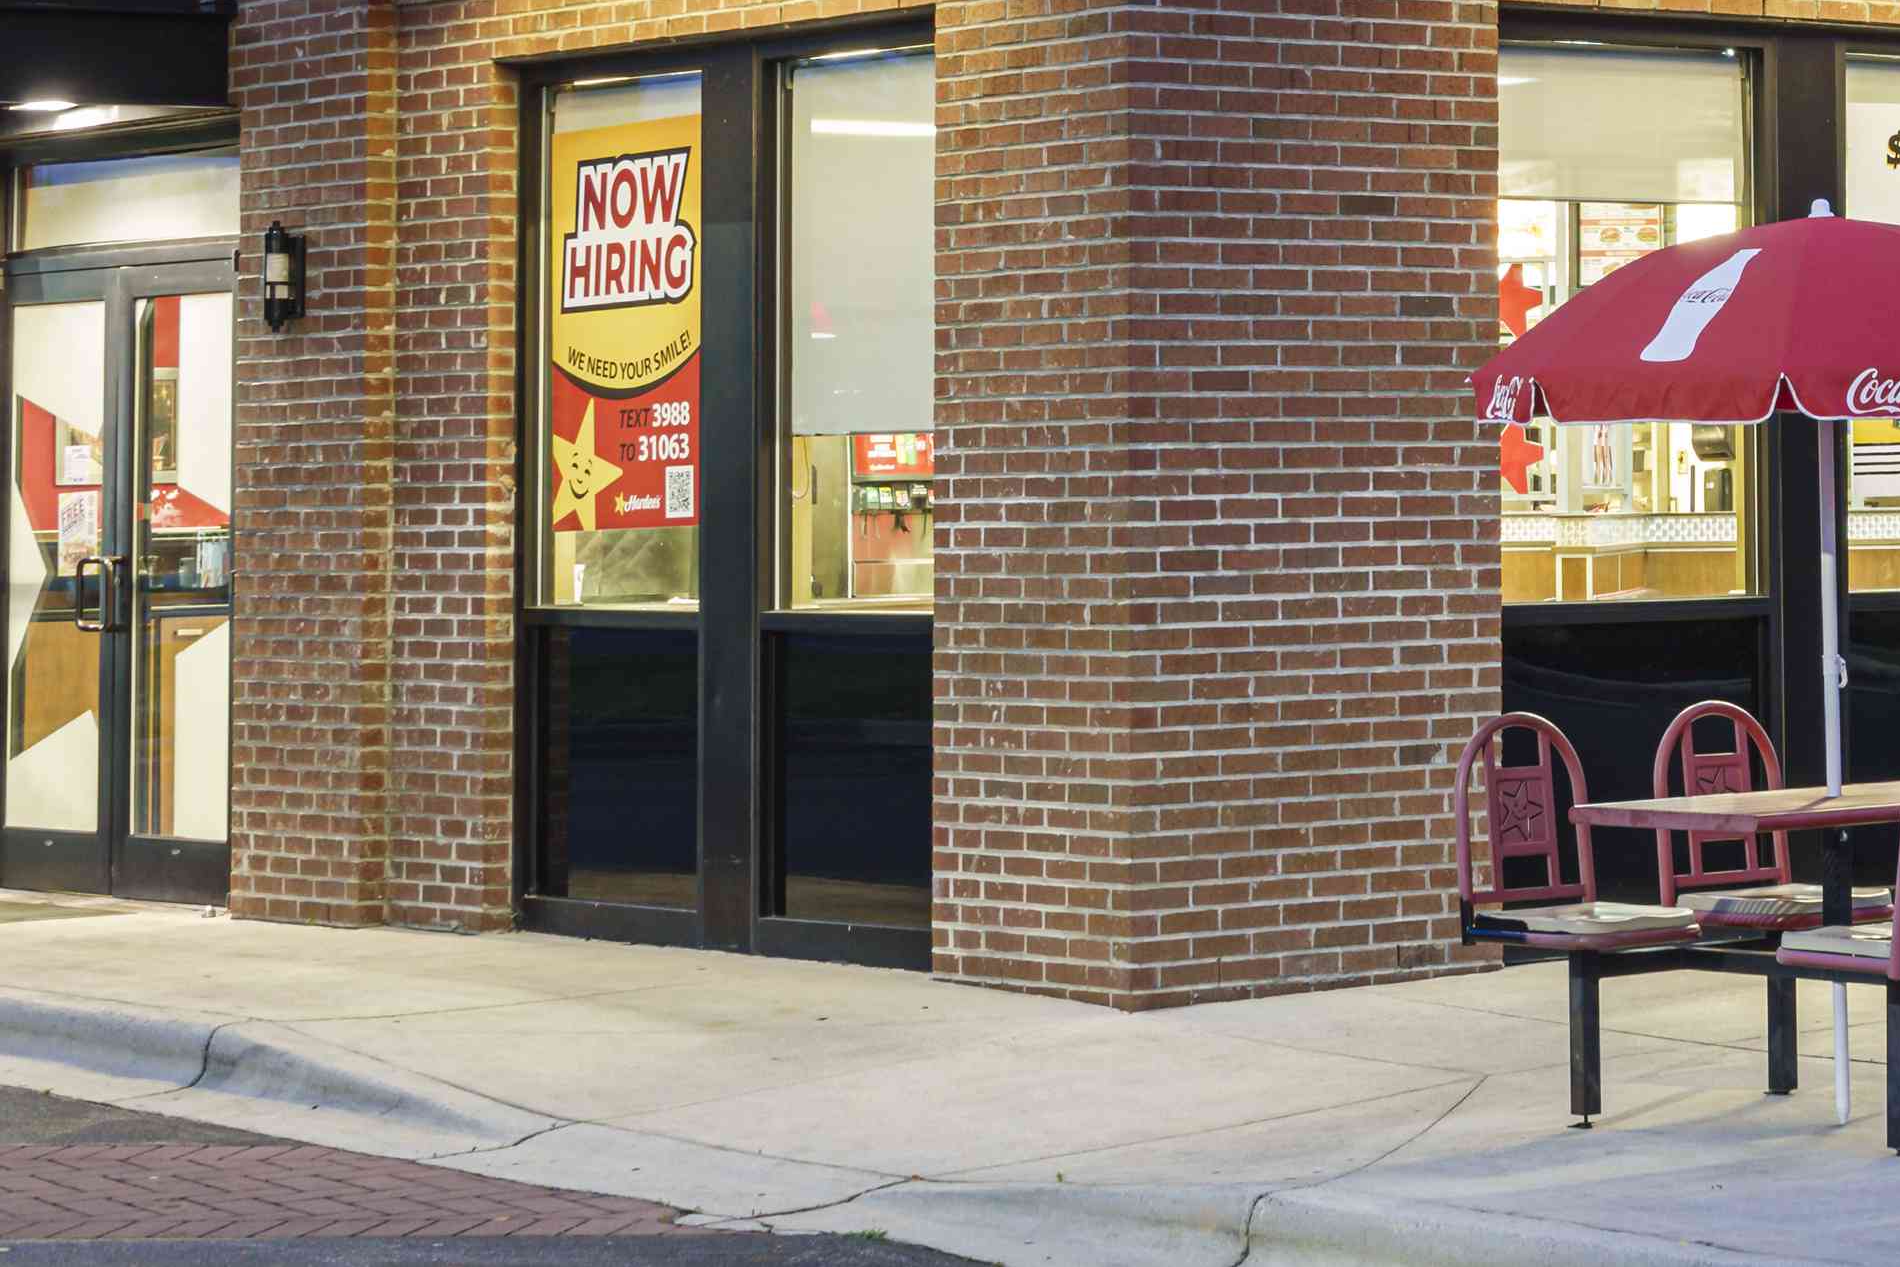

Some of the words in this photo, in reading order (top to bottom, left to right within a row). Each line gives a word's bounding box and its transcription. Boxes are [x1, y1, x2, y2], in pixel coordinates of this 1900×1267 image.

[583, 162, 680, 232] NOW
[569, 234, 687, 299] HIRING
[567, 346, 585, 371] WE
[587, 358, 617, 379] NEED
[619, 359, 652, 380] YOUR
[654, 330, 692, 371] SMILE!
[619, 408, 650, 429] TEXT
[651, 401, 690, 428] 3988
[619, 443, 636, 462] TO
[638, 434, 690, 462] 31063
